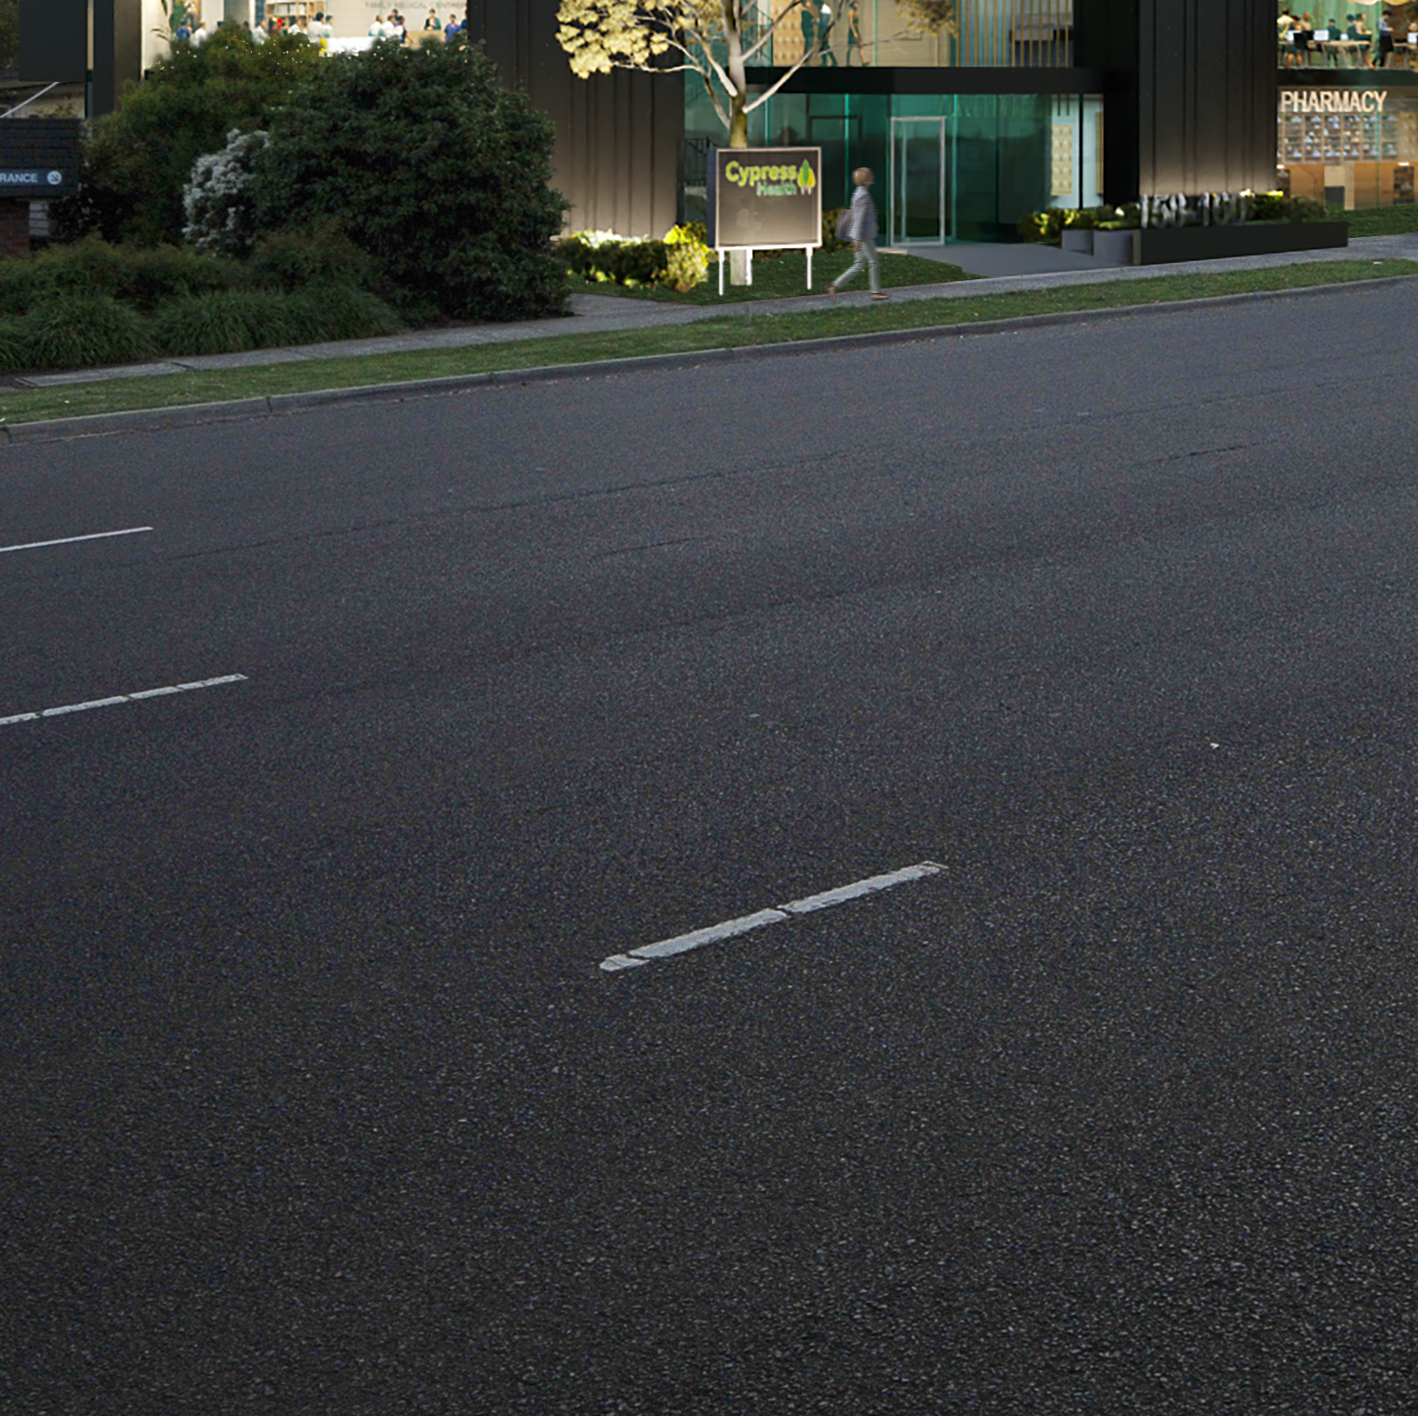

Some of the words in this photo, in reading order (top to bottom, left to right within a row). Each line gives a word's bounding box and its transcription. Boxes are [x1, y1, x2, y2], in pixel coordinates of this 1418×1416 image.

[1280, 90, 1388, 112] PHARMACY
[725, 160, 797, 187] Cypress
[756, 181, 798, 196] Health
